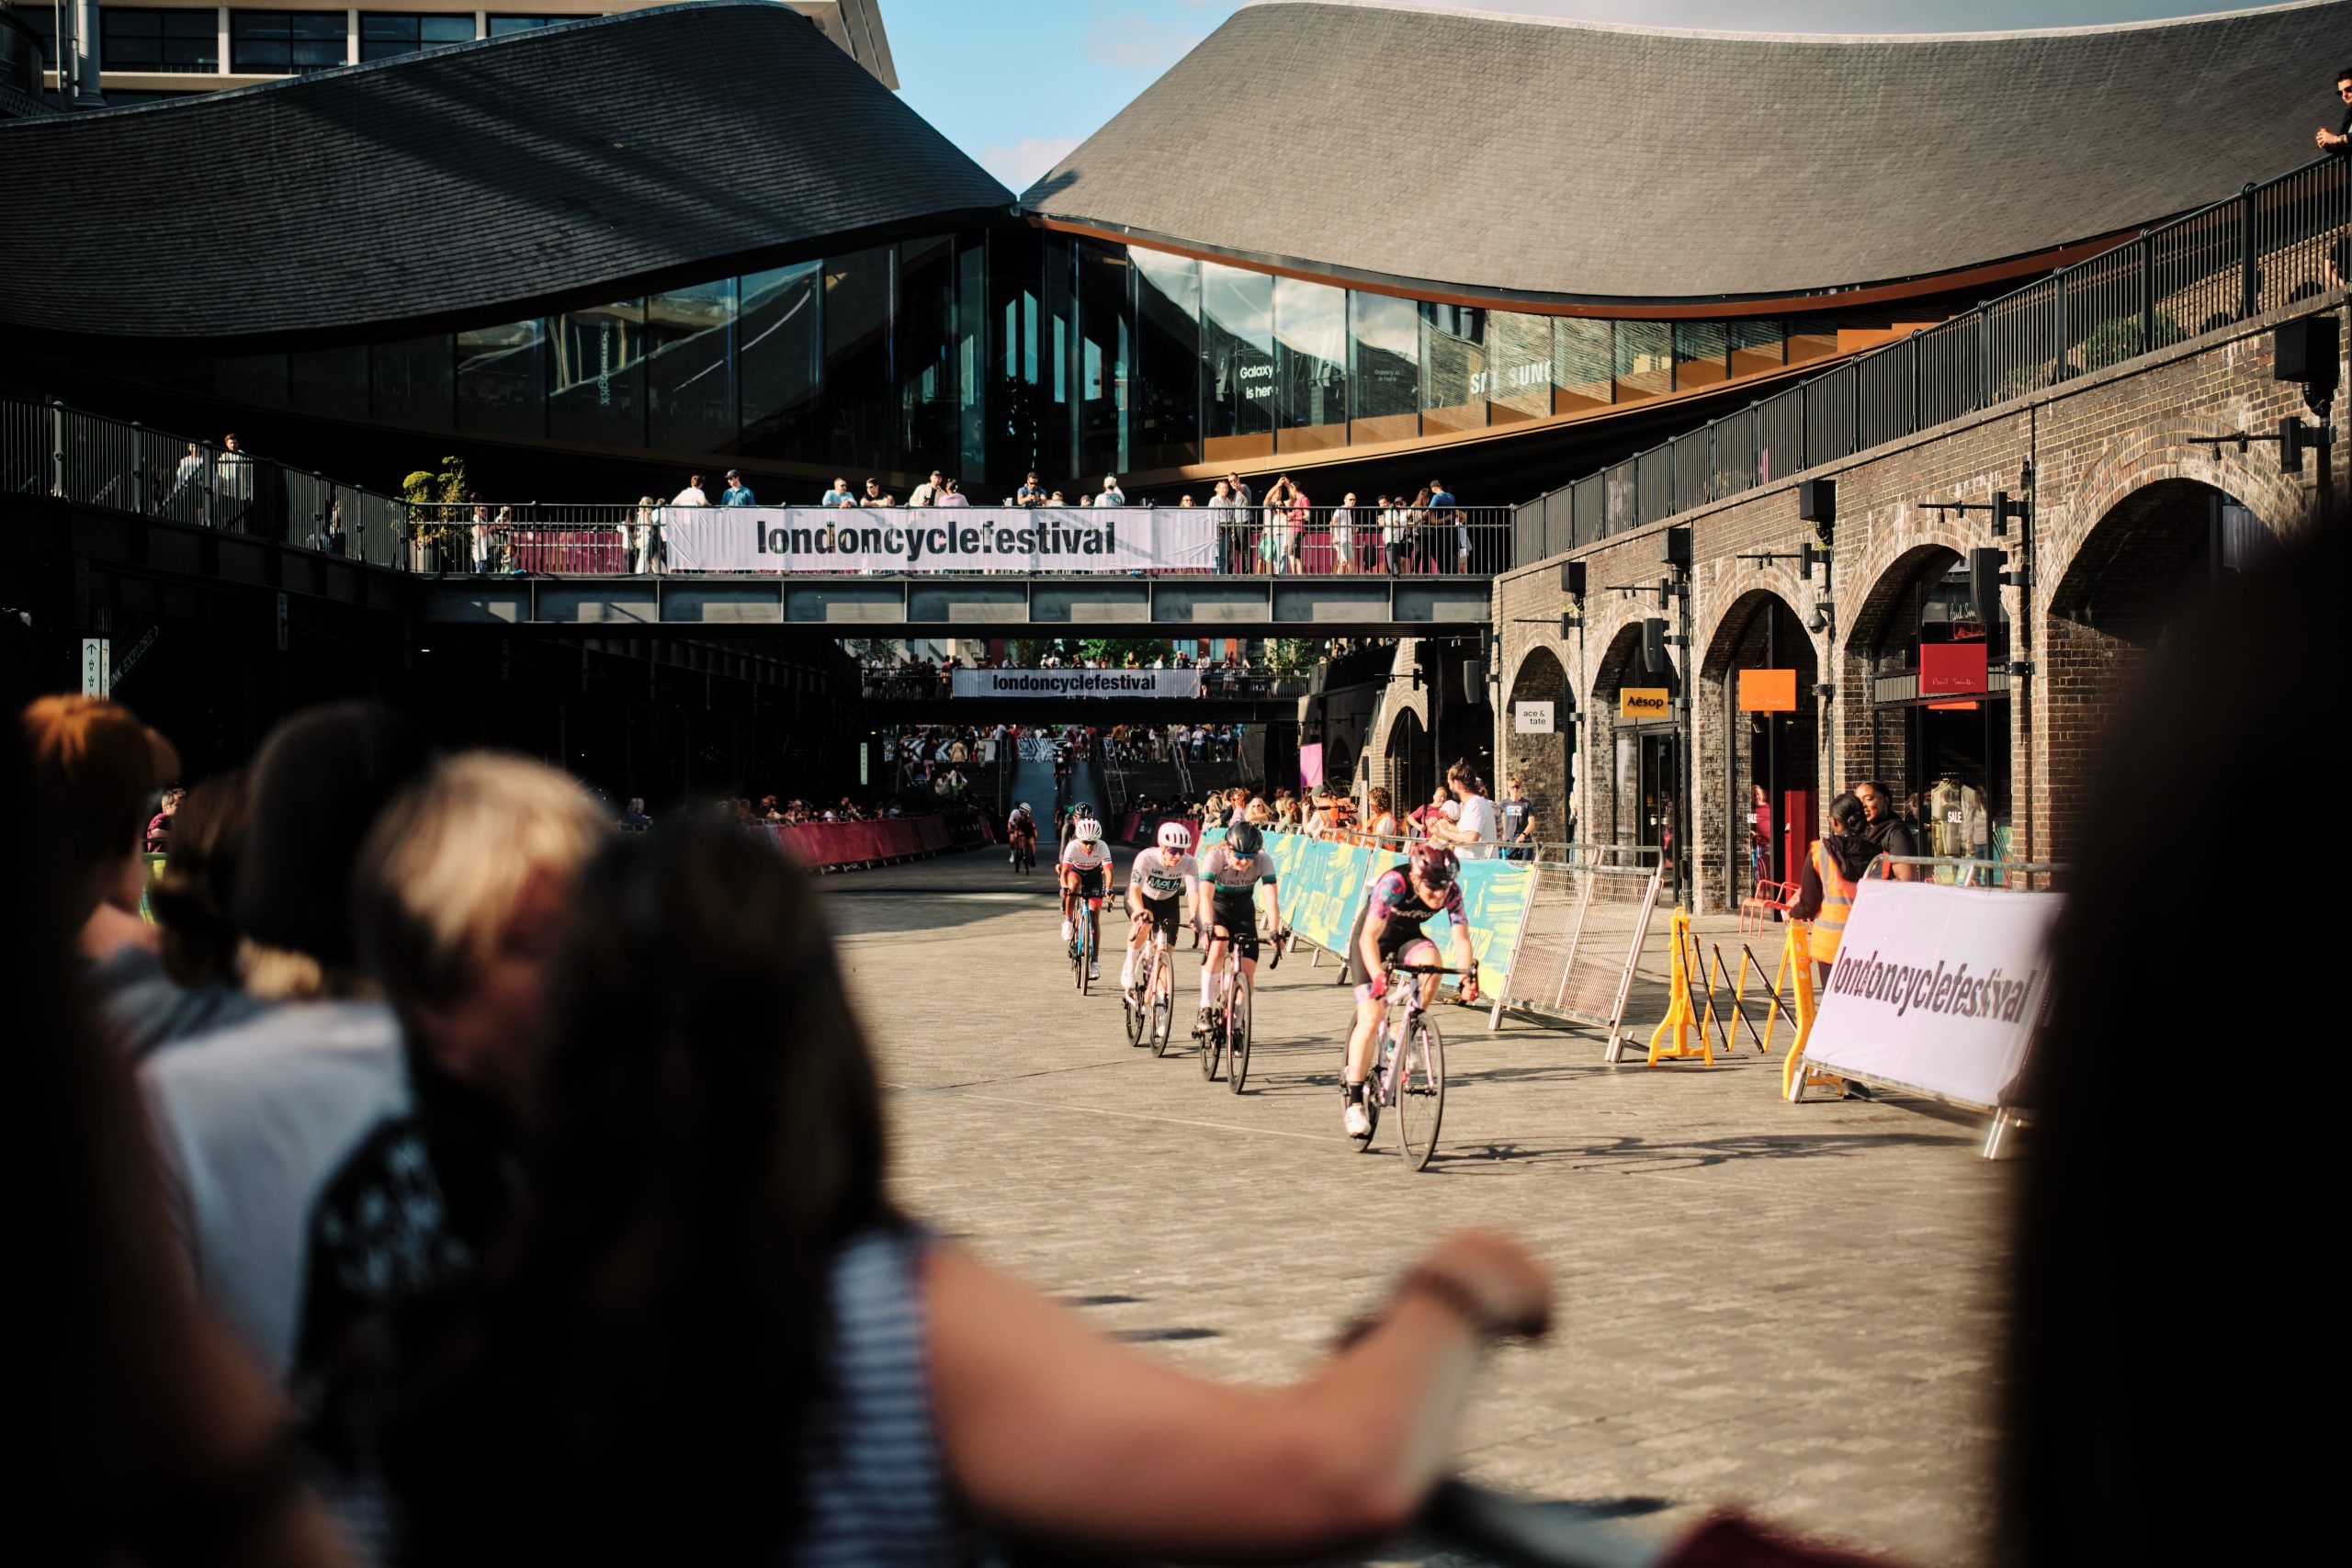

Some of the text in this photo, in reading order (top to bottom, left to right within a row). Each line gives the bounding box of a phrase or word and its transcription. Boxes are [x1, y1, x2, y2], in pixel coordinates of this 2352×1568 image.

[1240, 365, 1273, 379] Galaxy
[1246, 386, 1254, 400] is
[757, 520, 1115, 561] londoncyclefestival
[1950, 604, 1963, 623] Paul
[992, 674, 1156, 694] londoncyclefestival
[1947, 810, 1962, 824] SALE
[1829, 946, 2038, 1024] londoncyclefestival
